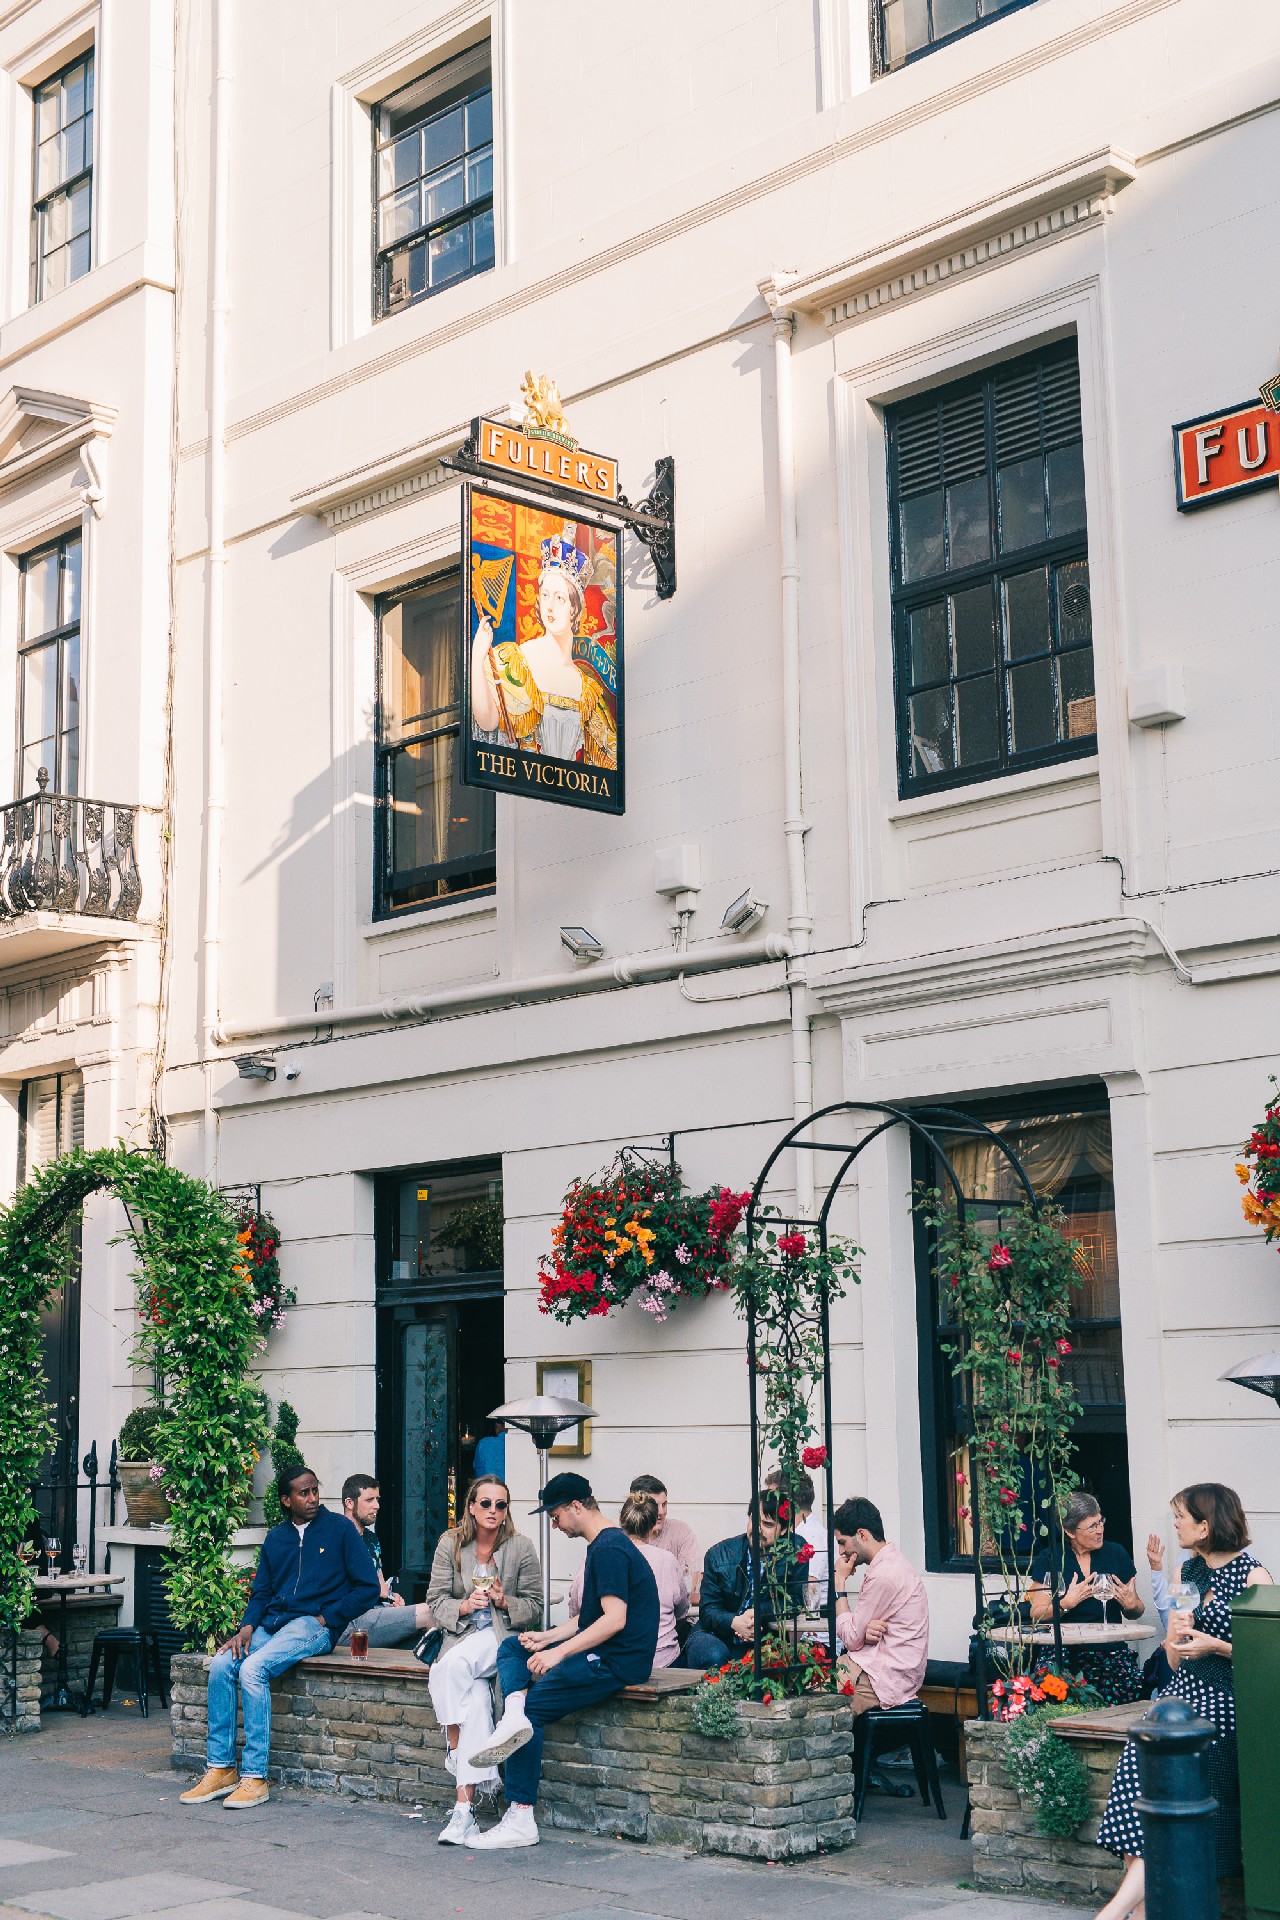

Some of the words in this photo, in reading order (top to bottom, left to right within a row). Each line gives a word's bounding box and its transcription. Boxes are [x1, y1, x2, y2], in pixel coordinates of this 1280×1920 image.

[488, 428, 609, 490] FULLER'S
[477, 751, 517, 777] THE
[521, 760, 611, 797] VICTORIA
